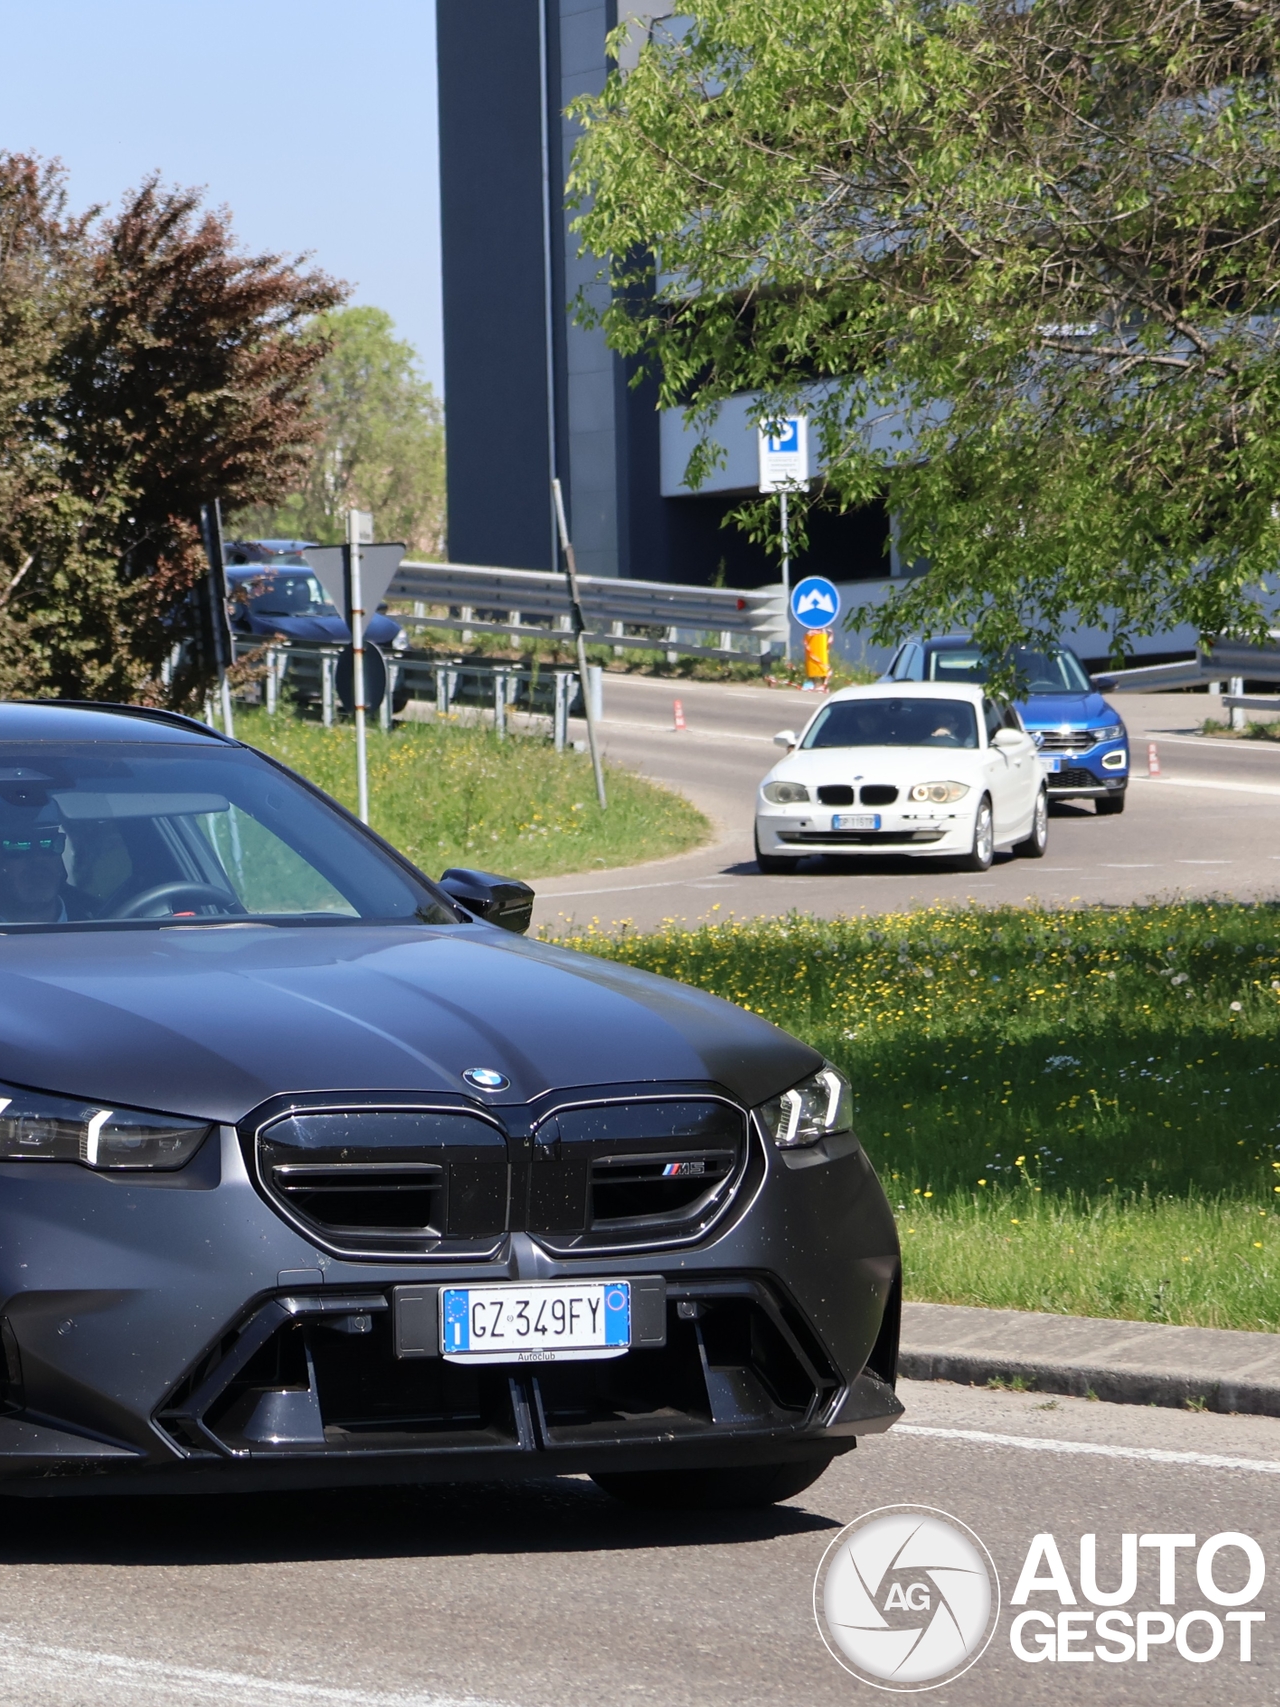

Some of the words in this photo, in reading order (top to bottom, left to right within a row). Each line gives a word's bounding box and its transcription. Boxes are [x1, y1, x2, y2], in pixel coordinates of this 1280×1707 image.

[772, 421, 794, 451] P
[675, 1161, 705, 1175] M5
[472, 1301, 505, 1338] GZ
[515, 1298, 601, 1337] 349FY
[517, 1352, 556, 1361] Autoclub
